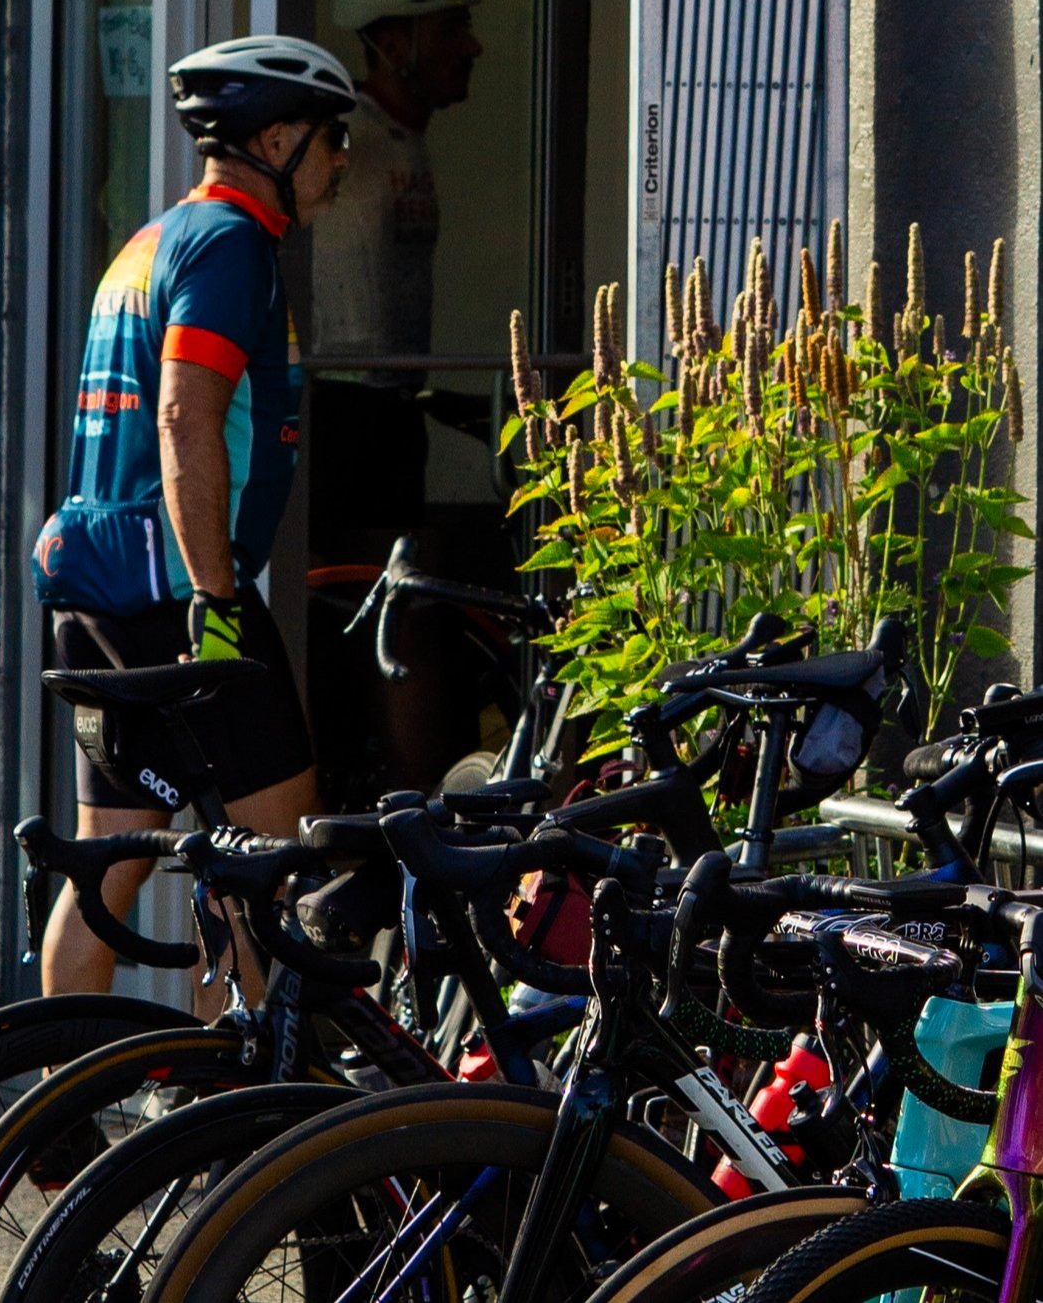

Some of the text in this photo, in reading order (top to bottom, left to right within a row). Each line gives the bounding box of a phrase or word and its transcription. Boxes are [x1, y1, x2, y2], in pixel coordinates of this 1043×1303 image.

[644, 103, 660, 194] Criterion
[76, 716, 97, 734] evoc
[139, 768, 179, 806] evoc
[695, 1066, 789, 1166] PARLEE
[18, 1187, 93, 1290] CONTINENTAL
